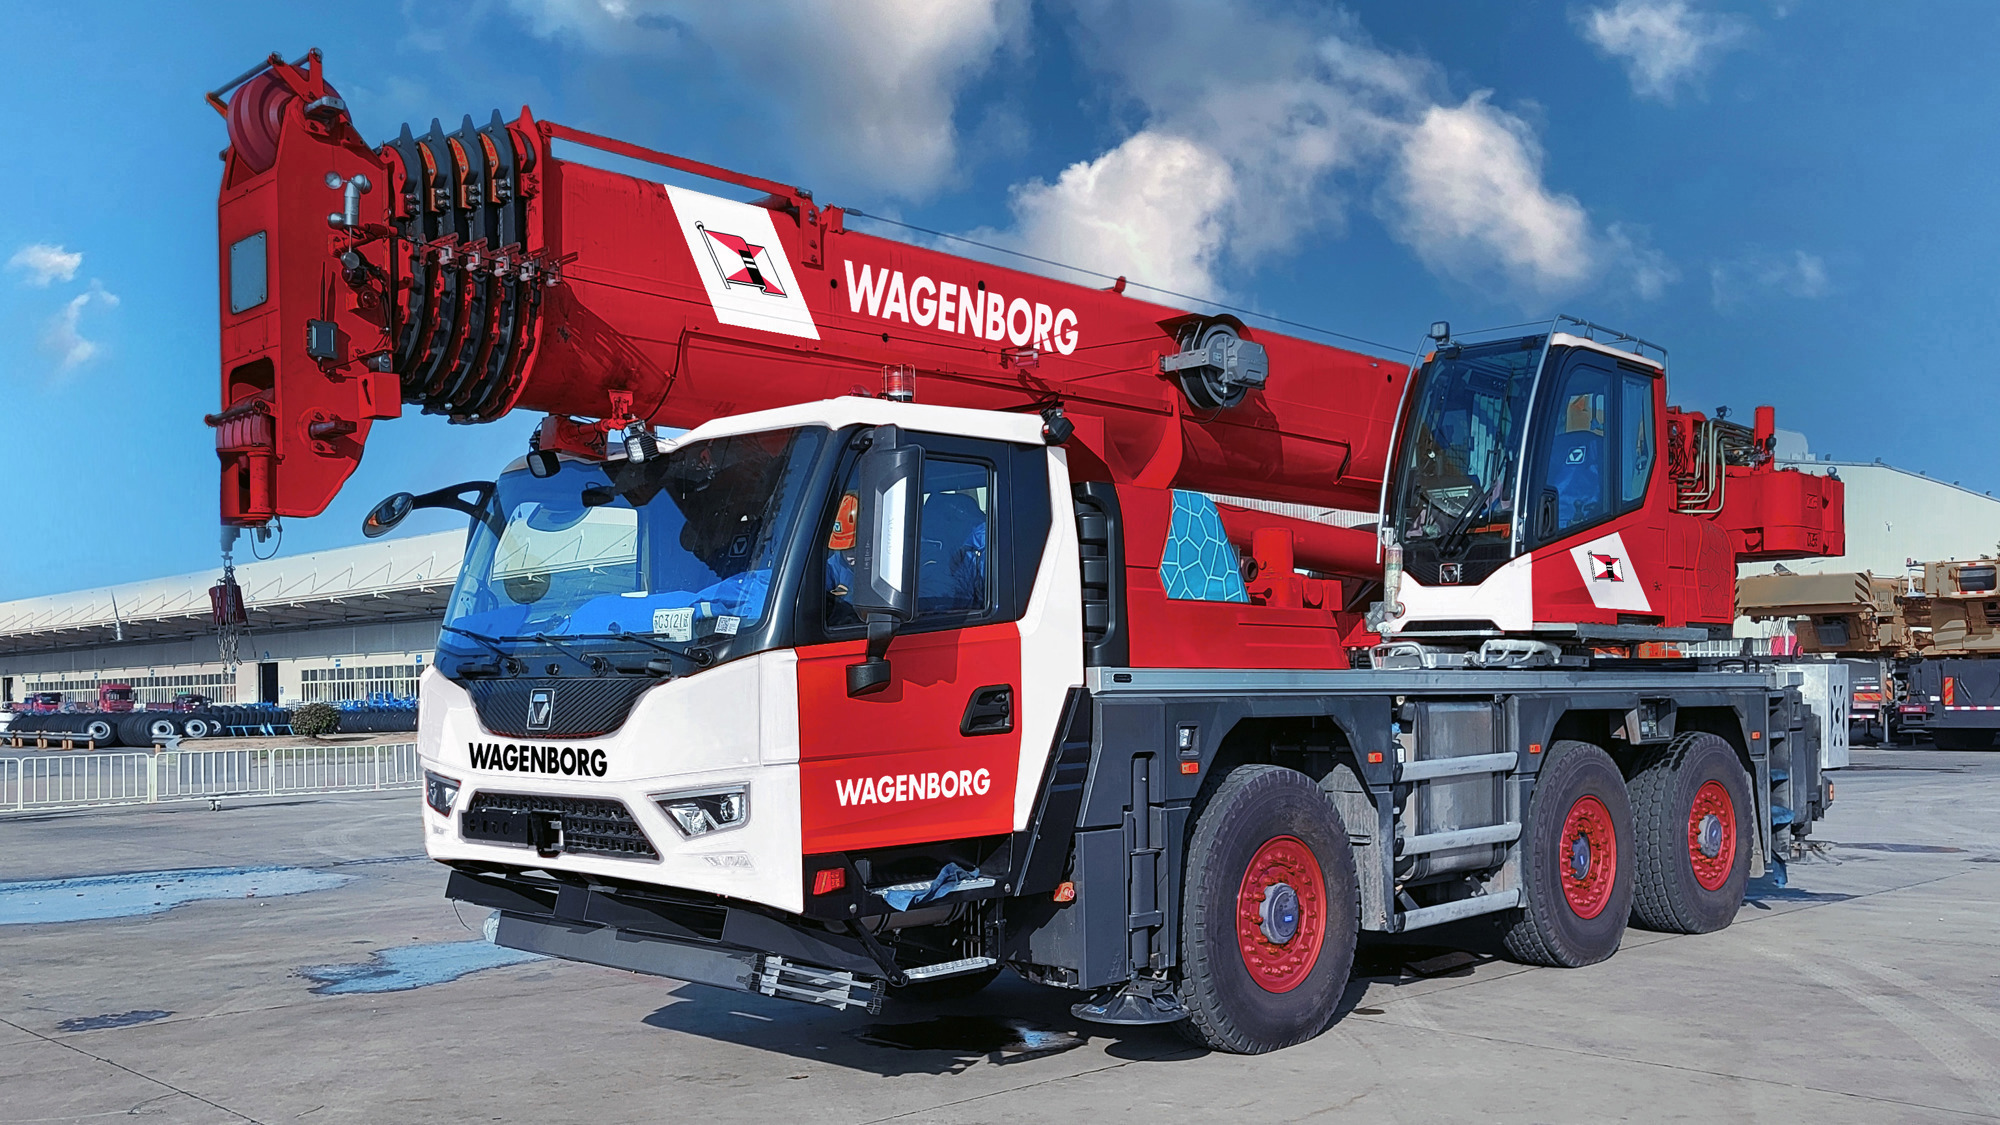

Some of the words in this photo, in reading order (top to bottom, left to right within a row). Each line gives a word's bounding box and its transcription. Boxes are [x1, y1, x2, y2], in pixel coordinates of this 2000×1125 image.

[844, 259, 1079, 356] WAGENBORG
[468, 742, 608, 777] WAGENBORG
[835, 767, 991, 807] WAGENBORG
